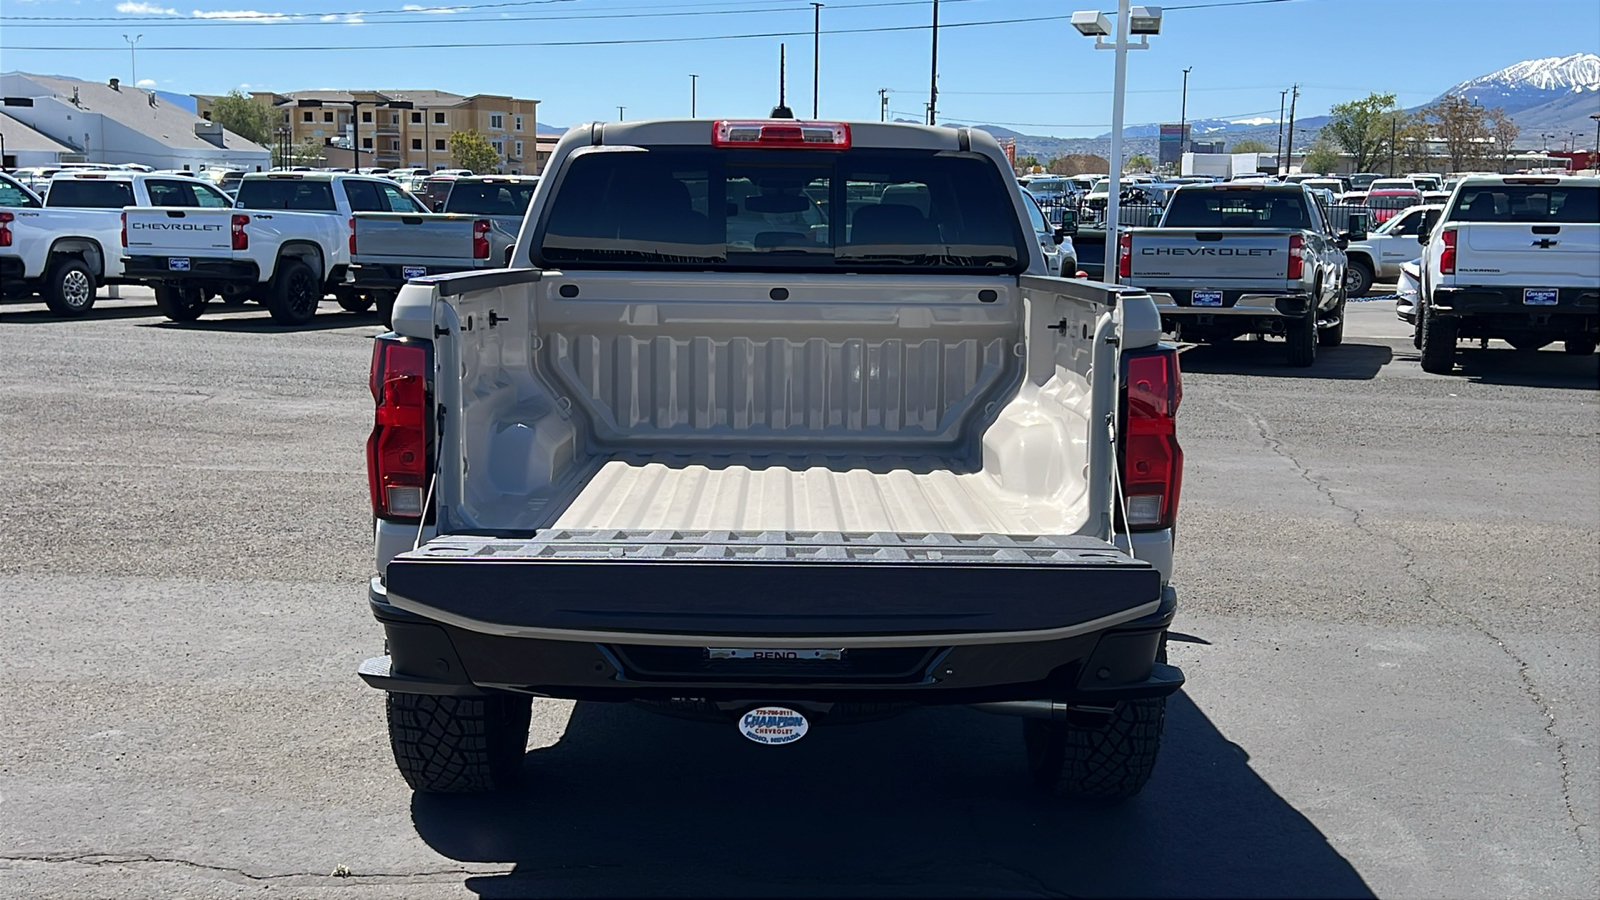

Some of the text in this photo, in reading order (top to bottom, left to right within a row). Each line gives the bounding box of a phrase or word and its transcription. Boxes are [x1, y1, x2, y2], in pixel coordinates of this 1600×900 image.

[132, 222, 224, 231] CHEVROLET
[1142, 248, 1278, 256] CHEVROLET
[743, 714, 804, 728] CHAMPION
[770, 732, 802, 743] NEVADA
